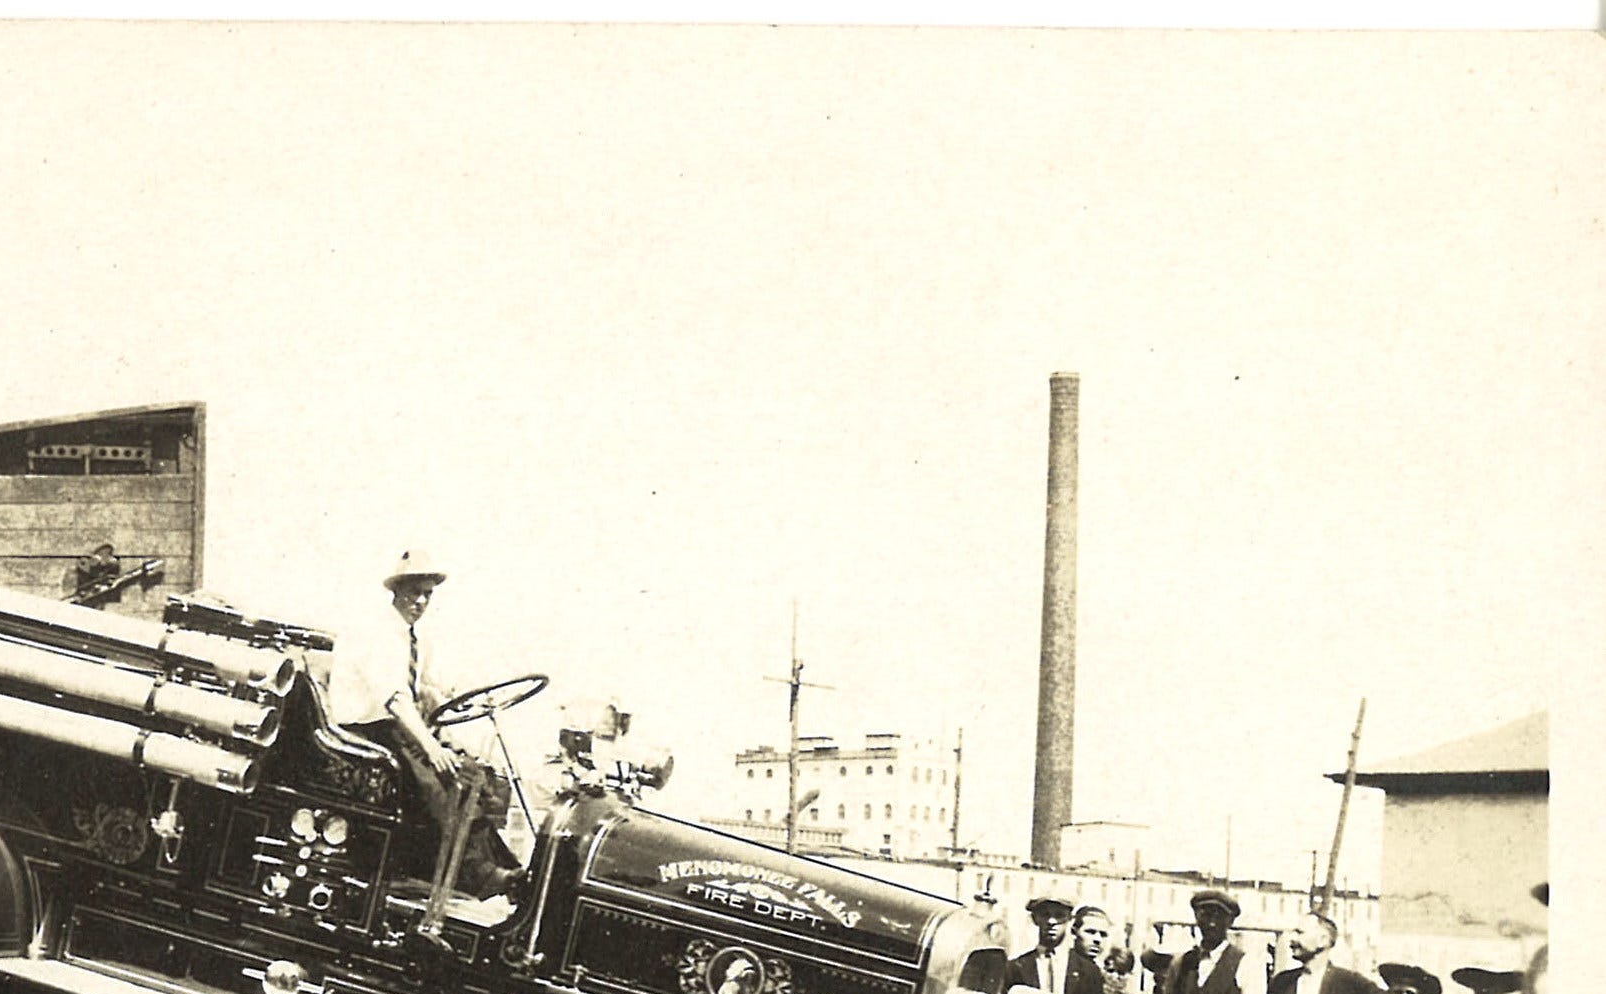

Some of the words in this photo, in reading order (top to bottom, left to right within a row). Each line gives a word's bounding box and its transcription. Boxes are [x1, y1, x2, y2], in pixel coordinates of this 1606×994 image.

[658, 859, 799, 890] MENOMONEE
[796, 882, 862, 929] FALLS
[685, 882, 748, 910] FIRE
[753, 899, 827, 931] DEPT.
